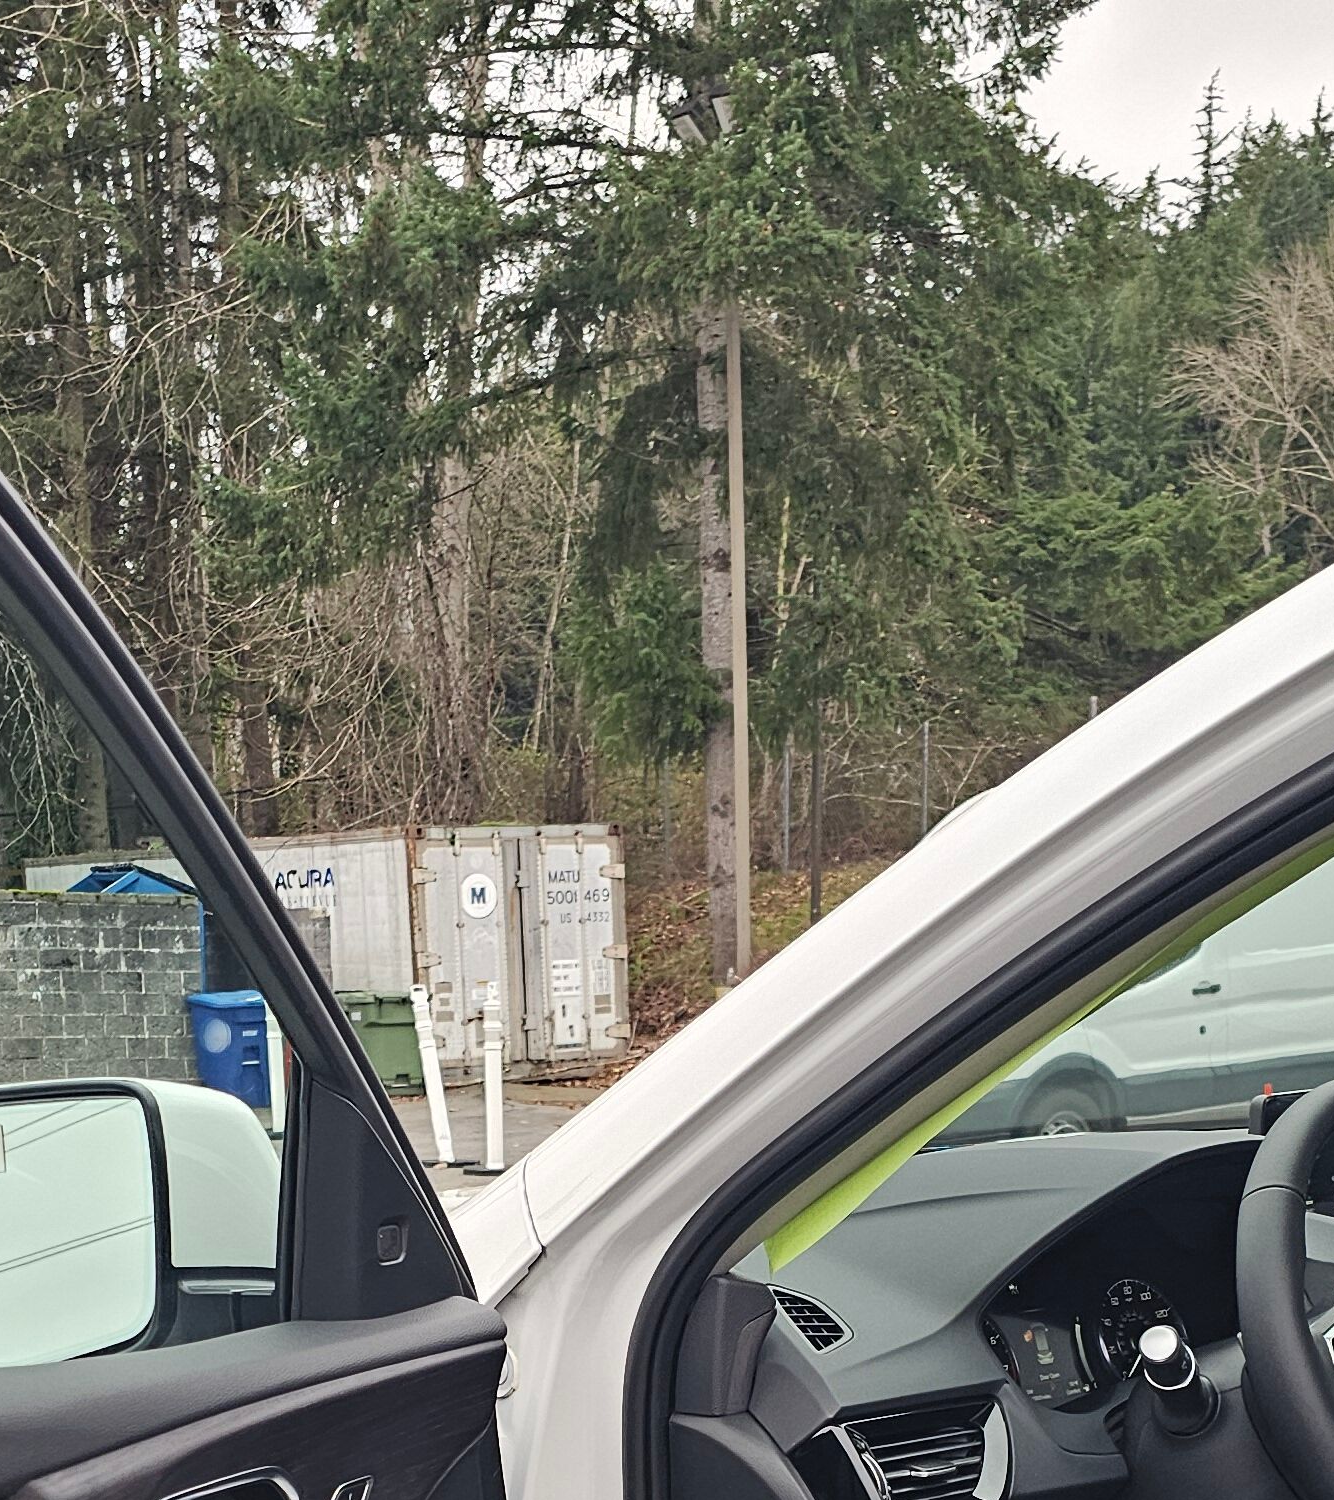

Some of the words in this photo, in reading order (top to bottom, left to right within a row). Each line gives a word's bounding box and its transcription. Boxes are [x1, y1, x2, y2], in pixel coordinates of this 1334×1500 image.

[274, 867, 335, 890] ACURA
[548, 870, 580, 884] MATU
[470, 887, 486, 904] M
[584, 888, 610, 902] 469
